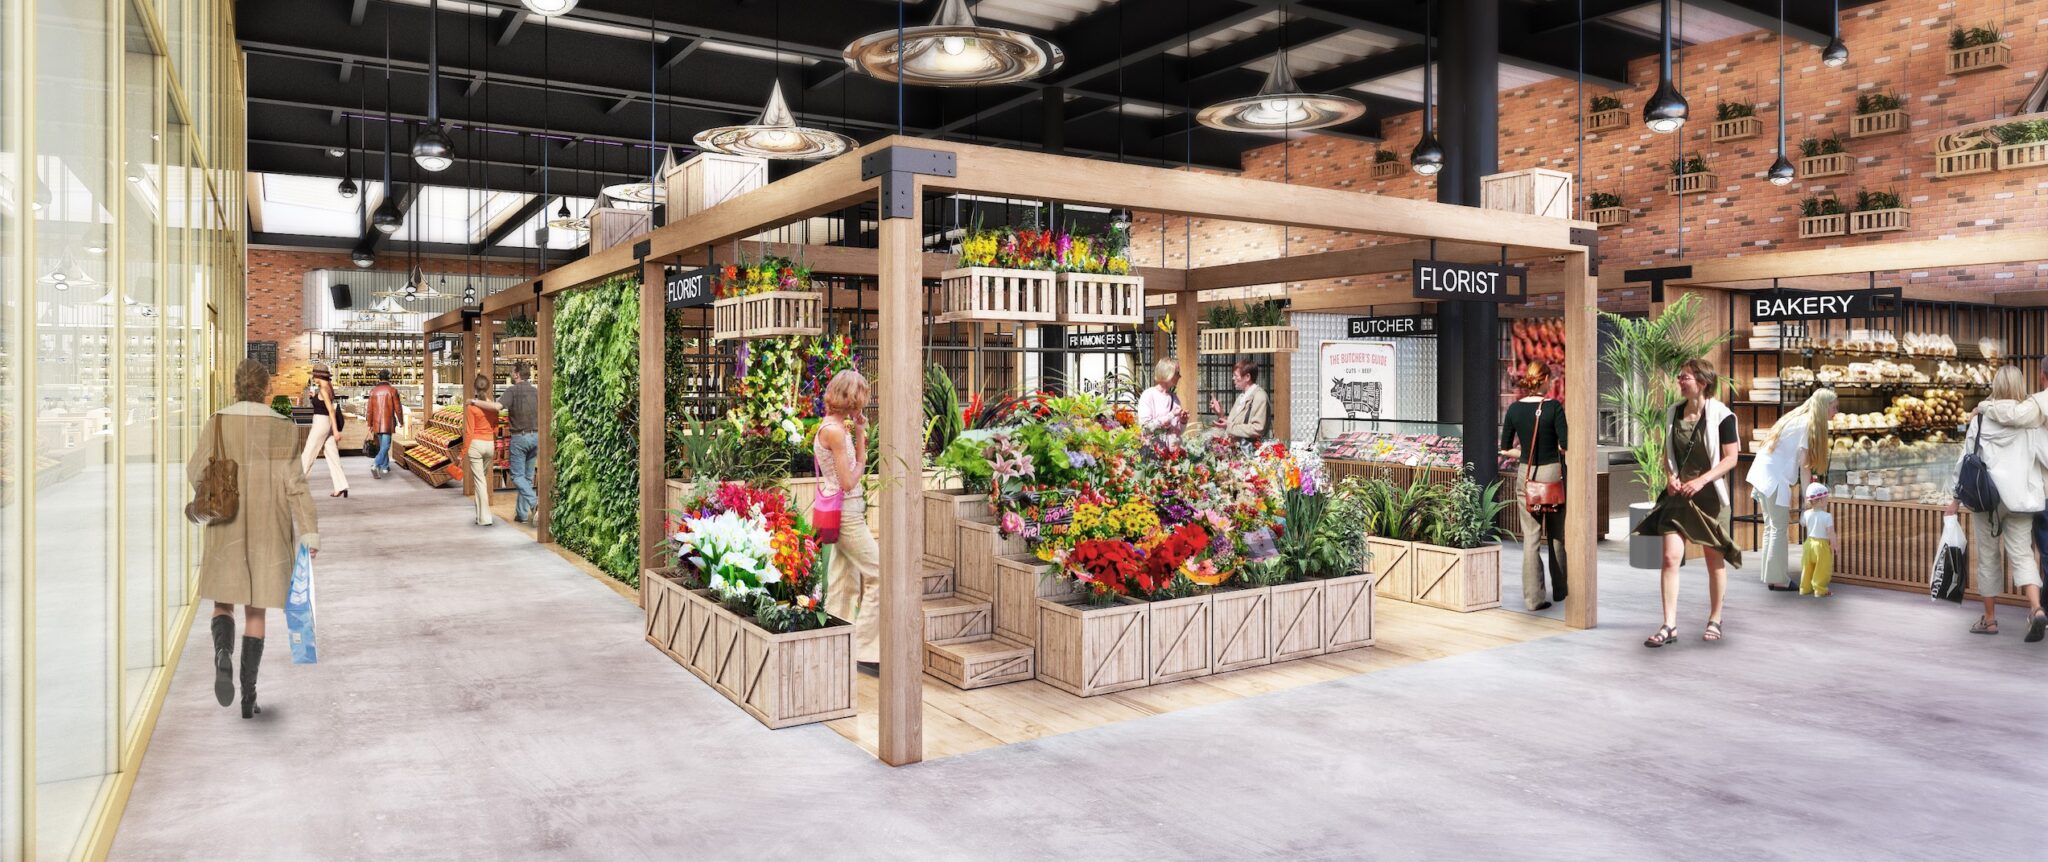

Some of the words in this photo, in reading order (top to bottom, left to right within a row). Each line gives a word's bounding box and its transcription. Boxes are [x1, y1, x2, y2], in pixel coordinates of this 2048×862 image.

[1420, 267, 1499, 294] FLORIST
[668, 275, 703, 303] FLORIST
[1756, 295, 1855, 317] BAKERY
[1352, 318, 1414, 334] BUTCHER
[1329, 354, 1340, 366] THE
[1340, 352, 1371, 364] BUTCHER'S
[1371, 353, 1388, 367] GUIDE
[1345, 367, 1357, 375] CUTS
[1361, 367, 1372, 375] BEEF
[1022, 523, 1068, 538] welcome
